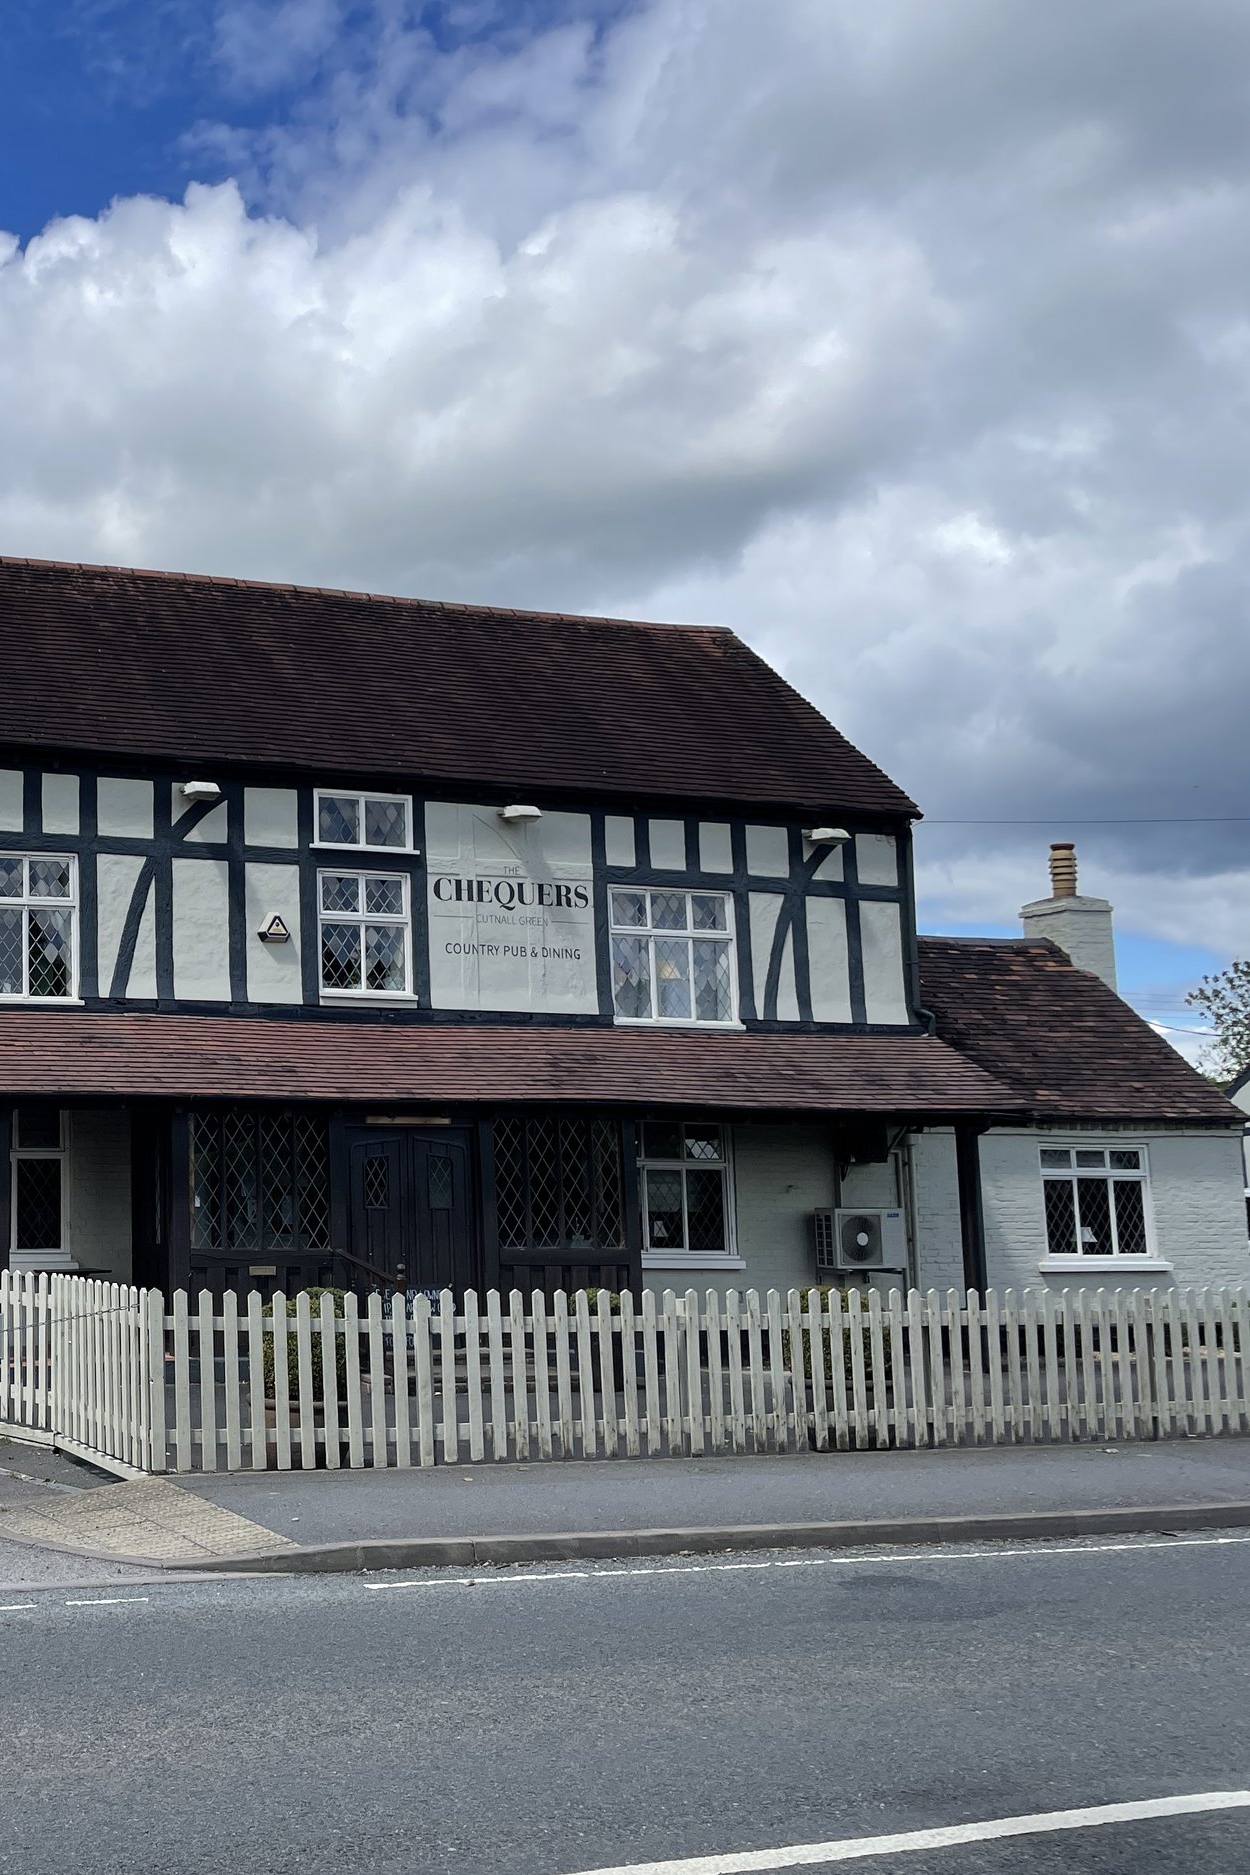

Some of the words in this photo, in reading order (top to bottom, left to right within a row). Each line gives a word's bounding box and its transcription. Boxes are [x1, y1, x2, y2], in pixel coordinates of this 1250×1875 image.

[503, 866, 520, 875] THE
[433, 877, 589, 911] CHEQUERS
[476, 914, 516, 925] CUTNALL
[519, 916, 549, 927] GREEN
[445, 943, 500, 956] COUNTRY
[503, 945, 527, 957] PUB
[530, 947, 538, 957] &
[542, 947, 581, 960] DINING
